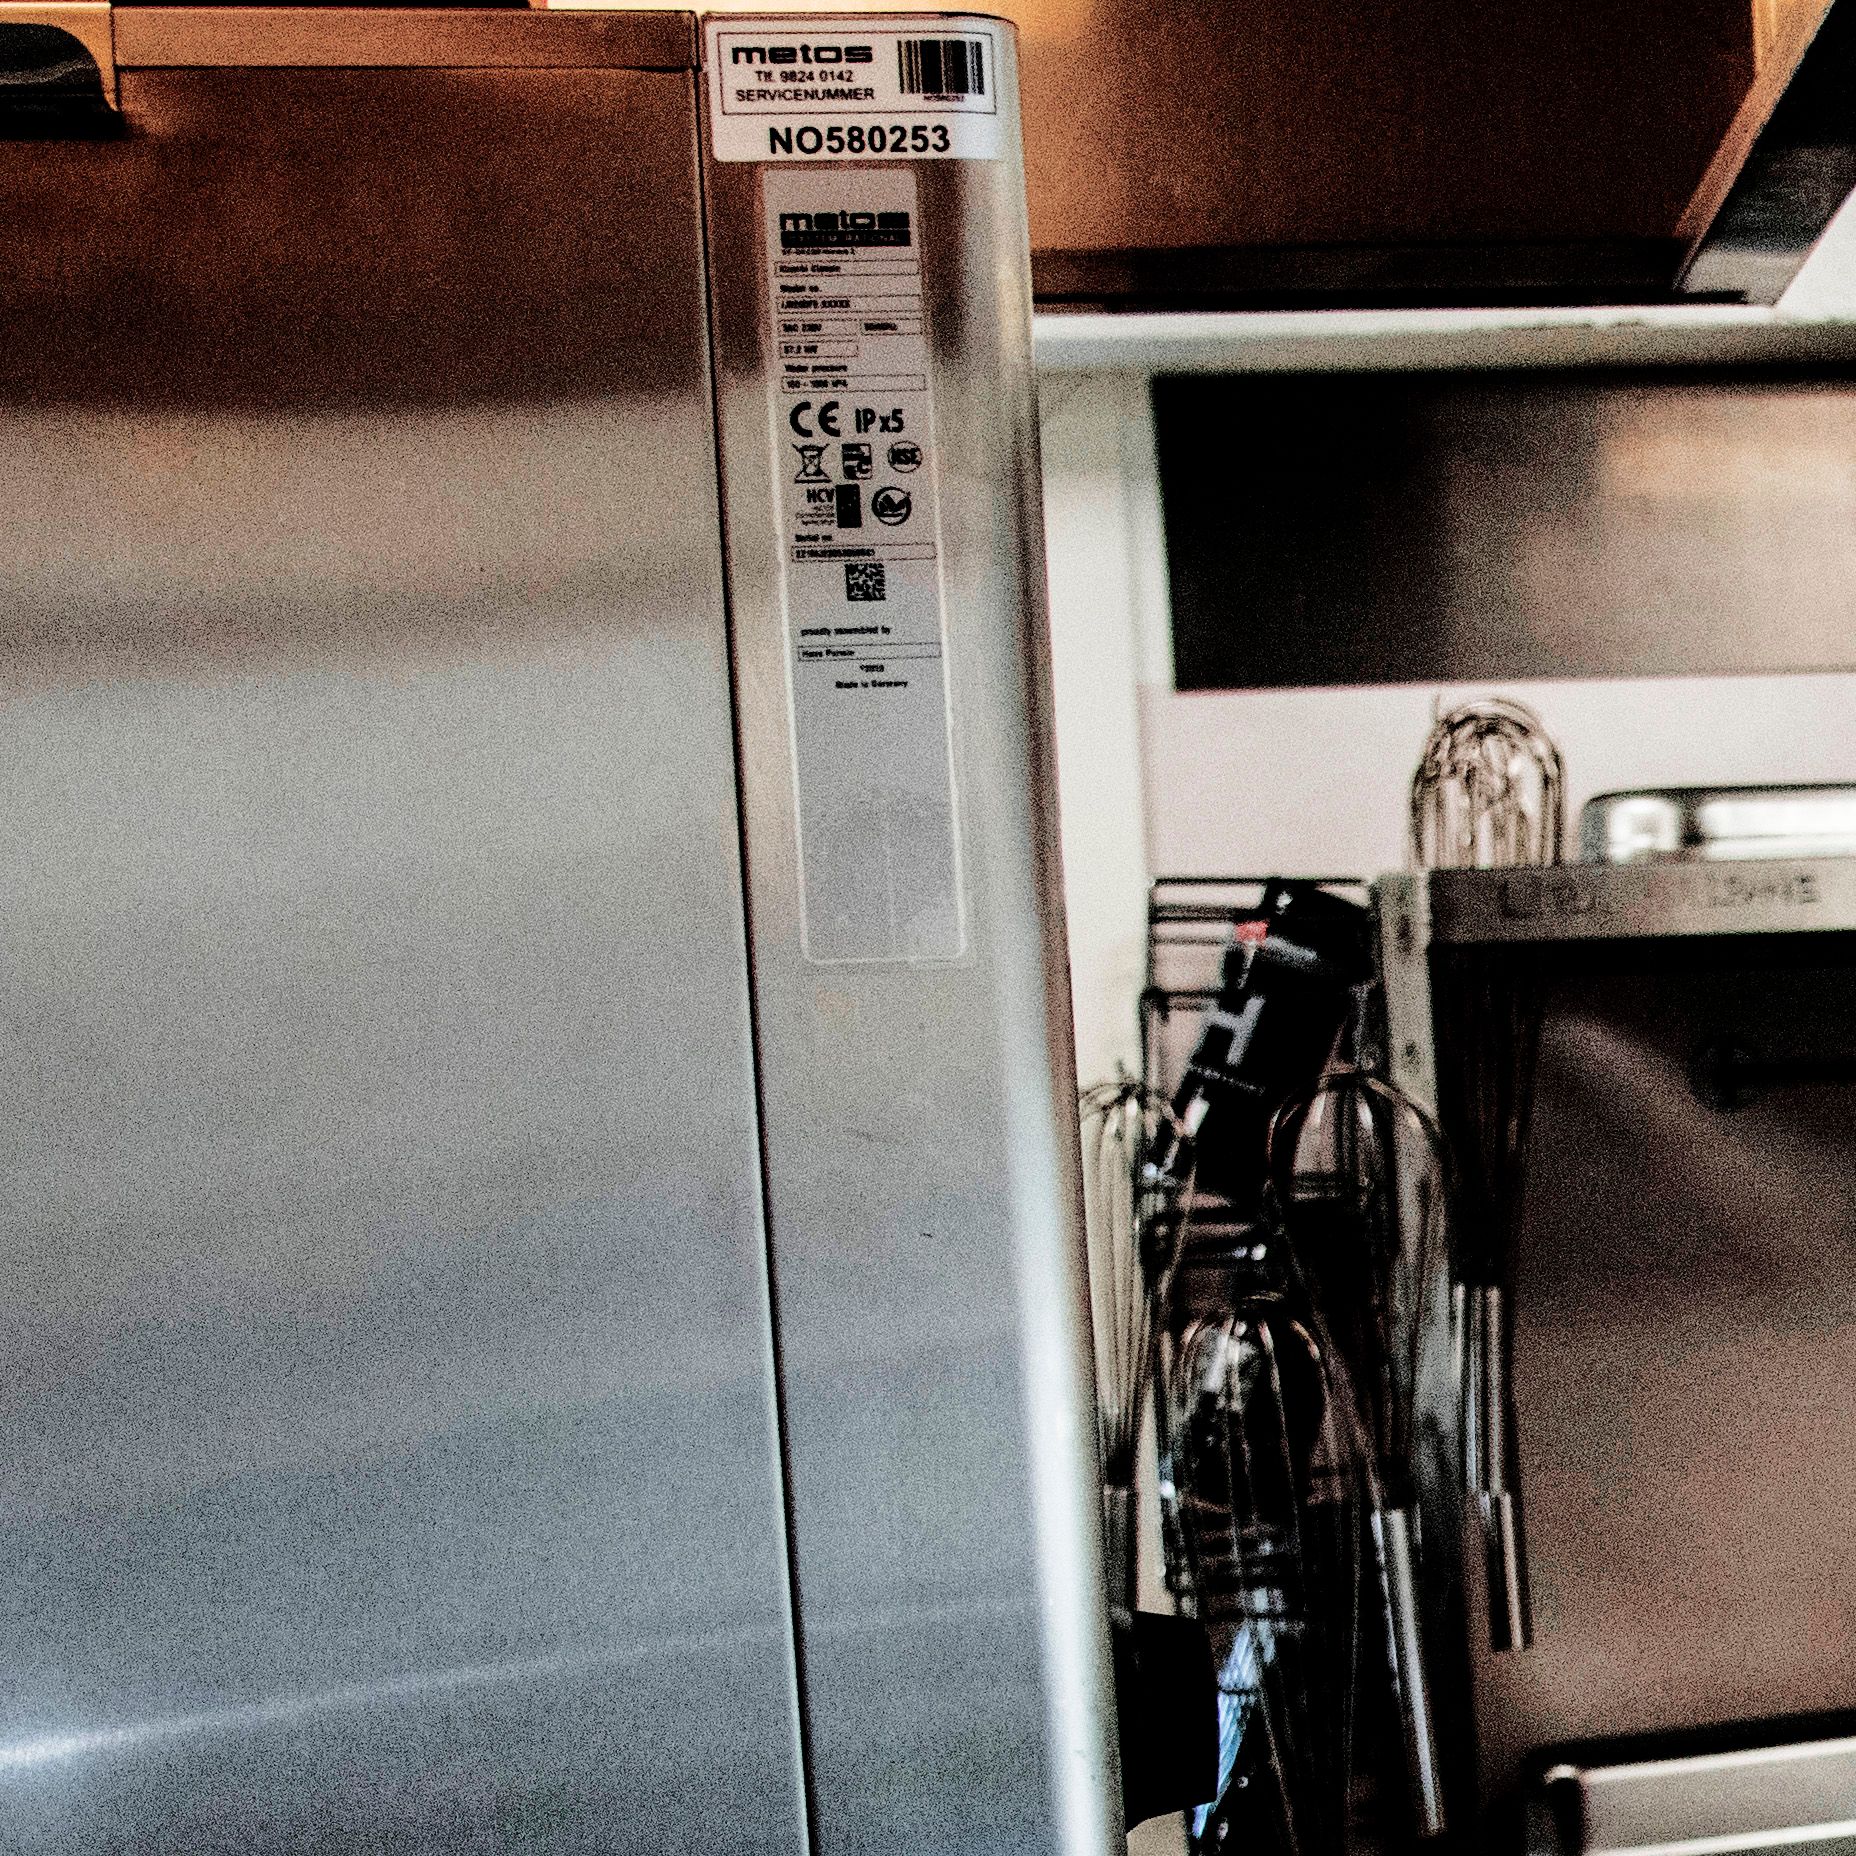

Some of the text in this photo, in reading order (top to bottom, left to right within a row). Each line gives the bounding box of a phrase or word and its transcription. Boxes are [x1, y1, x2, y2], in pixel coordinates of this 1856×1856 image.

[732, 44, 873, 65] metos
[780, 70, 815, 83] 9824
[819, 70, 854, 83] 0142
[736, 88, 875, 102] SERVICENUMMER
[769, 125, 951, 154] NO580253
[779, 210, 910, 230] metos
